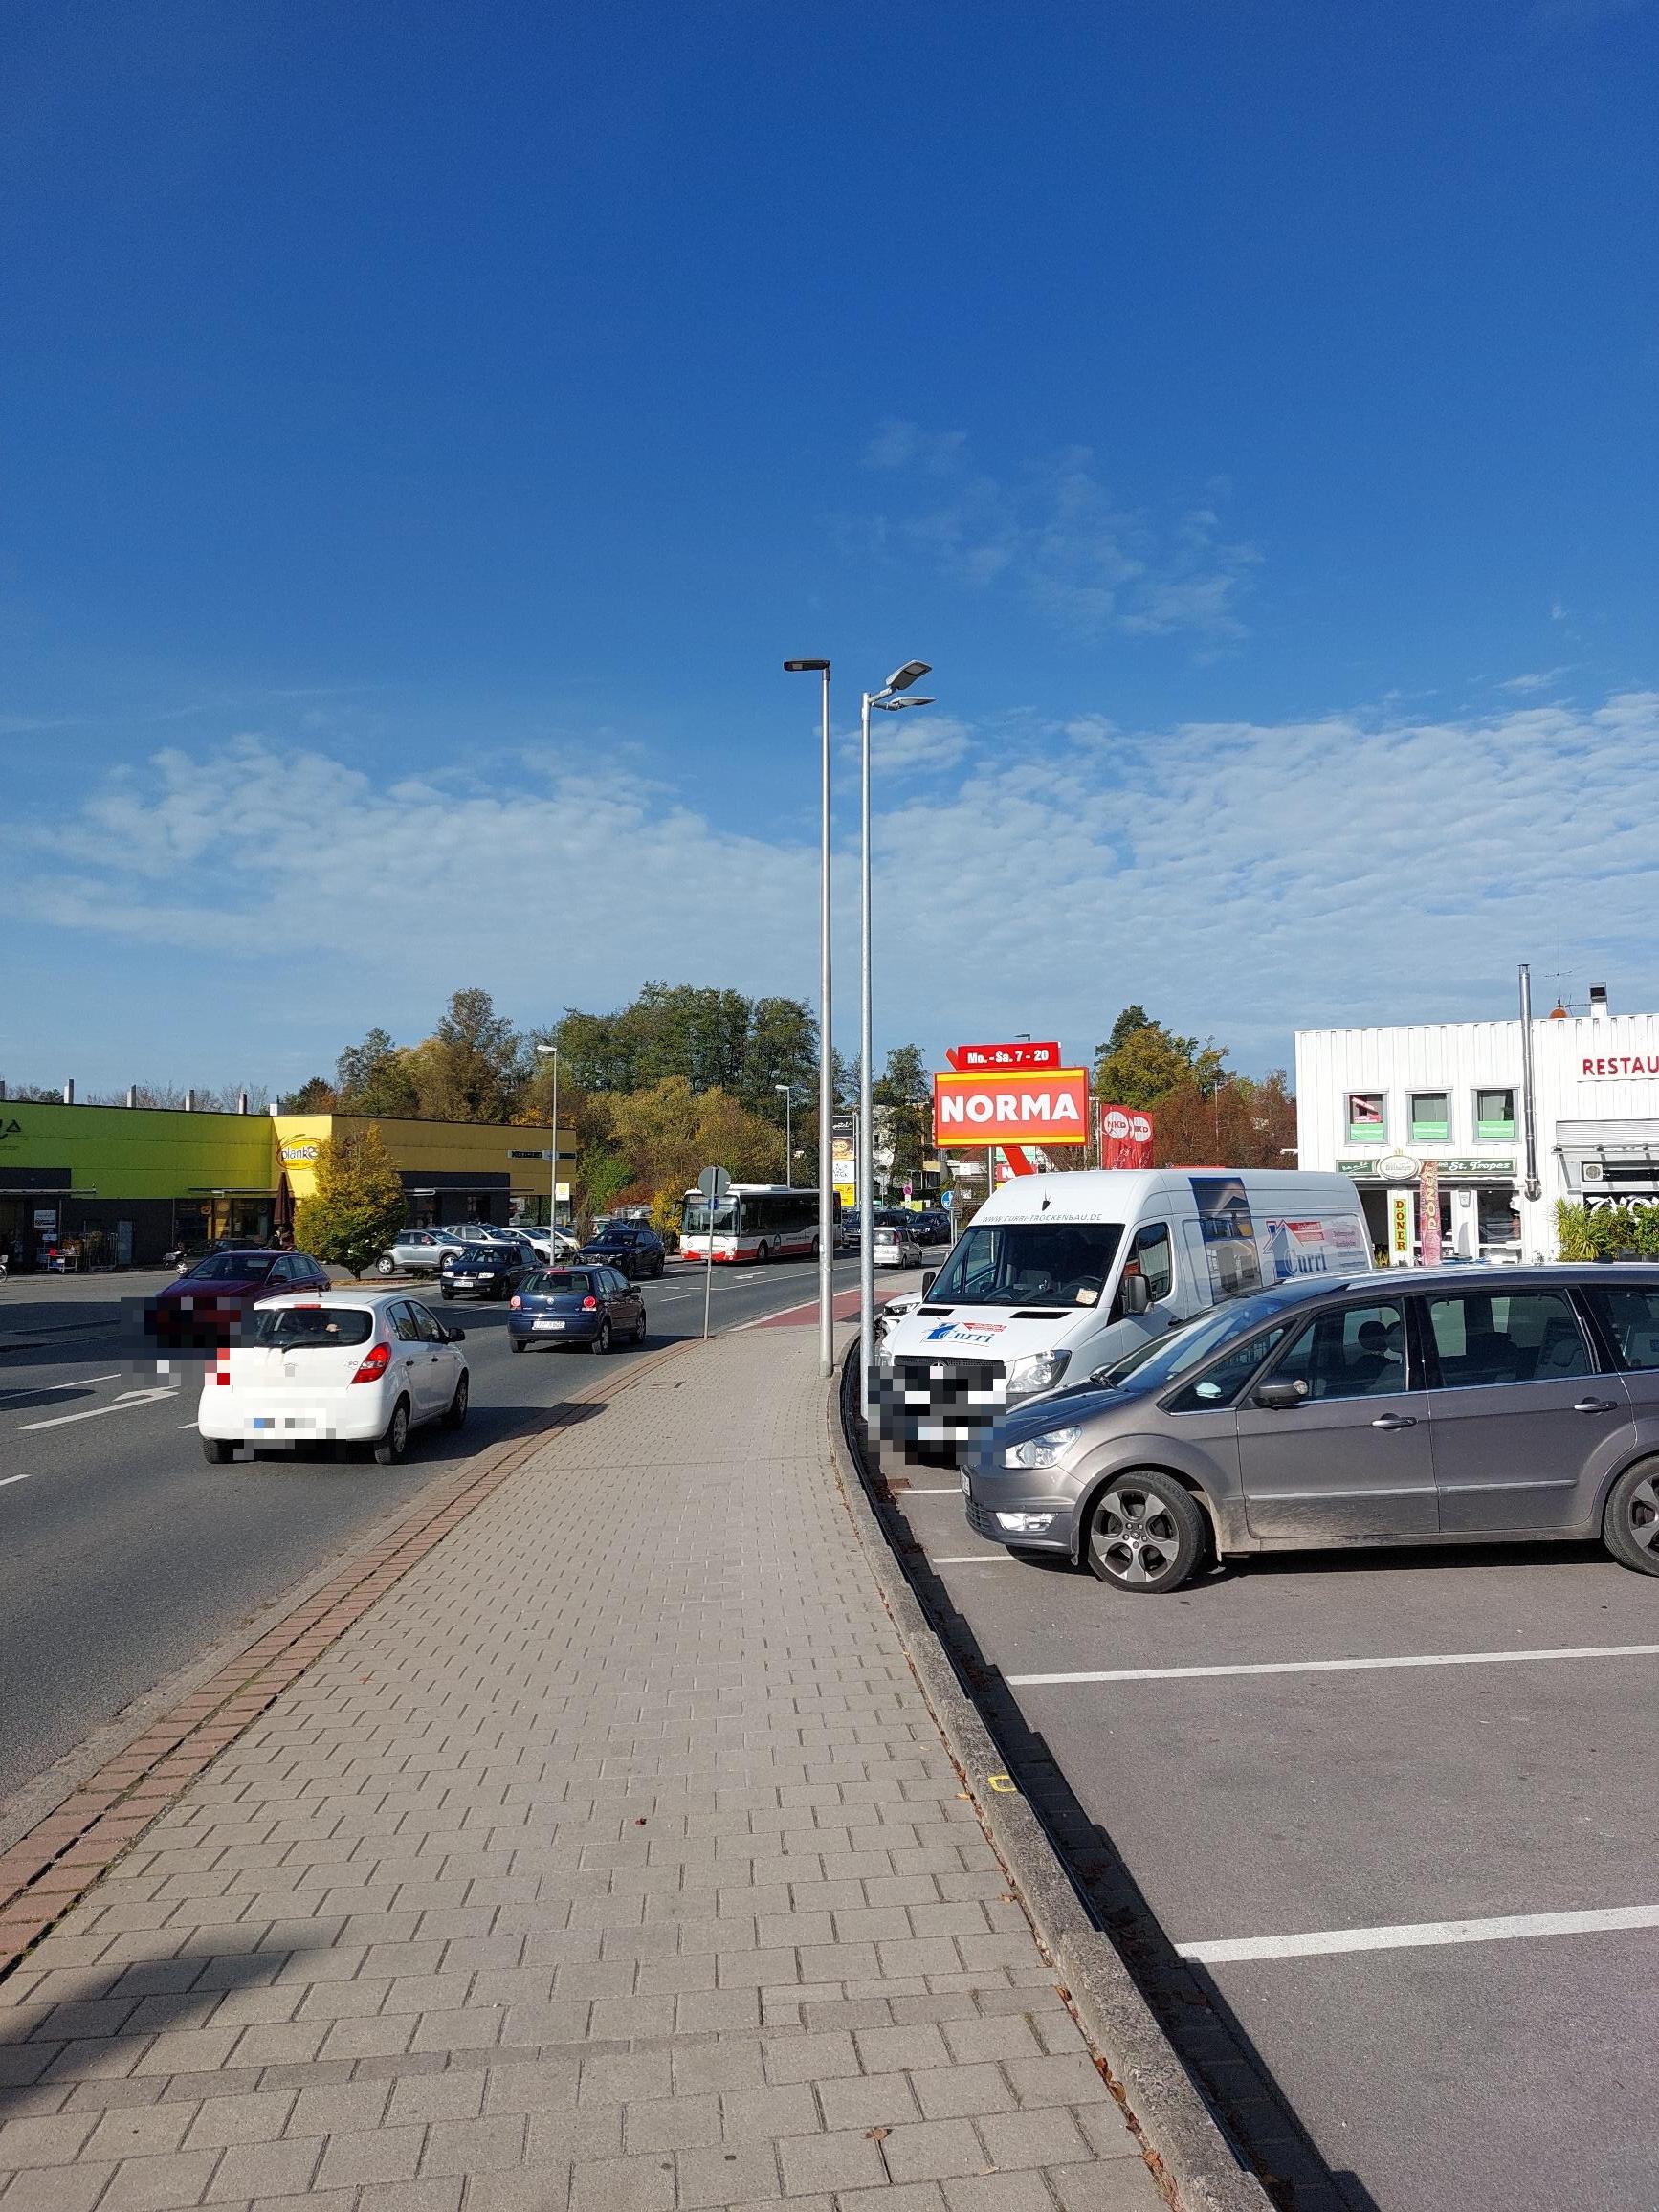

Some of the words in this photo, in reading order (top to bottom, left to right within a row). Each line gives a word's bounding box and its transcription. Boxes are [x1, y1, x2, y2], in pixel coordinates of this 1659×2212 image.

[1015, 1051, 1023, 1062] 7
[1033, 1049, 1049, 1062] 20
[1582, 1056, 1659, 1075] RESTAU
[941, 1093, 1080, 1123] NORMA
[1107, 1120, 1127, 1129] NKD
[1448, 1161, 1468, 1171] St.
[1469, 1161, 1512, 1171] Tropez
[983, 1213, 1103, 1223] WWW.CURRI-TROCKENBAU.DE
[1395, 1200, 1406, 1250] DÖNER
[1283, 1246, 1328, 1275] Curri
[939, 1331, 995, 1343] Curri
